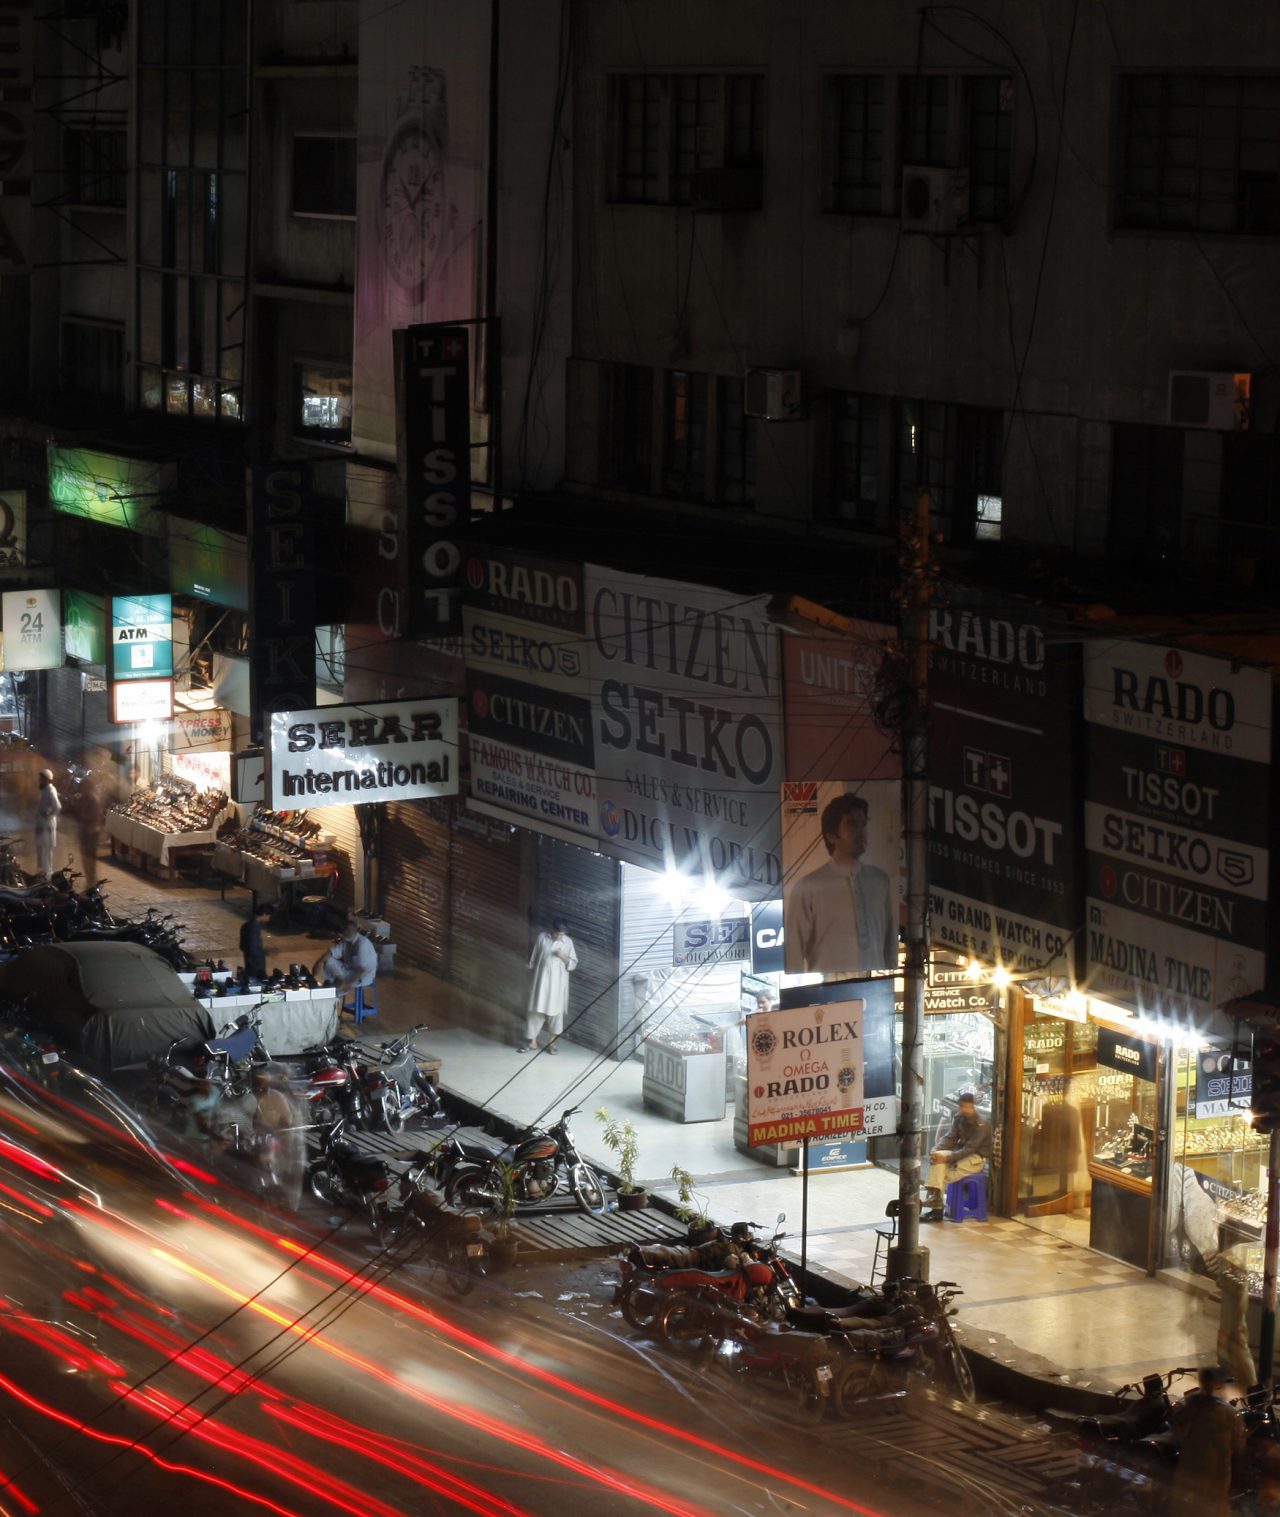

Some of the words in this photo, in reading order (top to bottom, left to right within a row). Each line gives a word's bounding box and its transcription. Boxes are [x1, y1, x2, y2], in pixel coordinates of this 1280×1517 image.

[420, 367, 460, 623] TISSOT
[265, 471, 309, 709] SEIK
[488, 560, 577, 612] RADO
[21, 612, 43, 633] 24
[119, 628, 147, 640] ATM
[592, 586, 769, 696] CITIZEN
[929, 608, 1046, 670] RADO
[472, 625, 555, 672] SEIKO
[560, 651, 578, 673] 5
[928, 653, 1046, 697] SWITZERLAND
[490, 694, 585, 746] CITIZEN
[1112, 668, 1234, 731] RADO
[178, 718, 223, 728] XPRESS
[191, 726, 230, 738] MONEY
[288, 713, 443, 752] SEHAR
[601, 679, 773, 785] SEIKO
[1113, 711, 1234, 749] SWITZERLAND
[283, 755, 449, 796] International
[472, 740, 522, 776] FAMOUS
[525, 754, 571, 792] WATCH
[574, 771, 596, 799] CO.
[477, 779, 537, 810] REPAIRING
[541, 799, 589, 826] CENTER
[525, 783, 560, 801] SERVICE
[625, 769, 669, 805] SALES
[672, 783, 682, 808] &
[686, 787, 748, 827] SERVICE
[1122, 766, 1219, 821] TISSOT
[929, 785, 1063, 866] TISSOT
[952, 849, 1000, 875] WATCHES
[1103, 814, 1211, 875] SEIKO
[1222, 853, 1248, 881] 5
[1122, 871, 1235, 934] CITIZEN
[684, 922, 750, 948] SEI
[929, 895, 944, 915] EW
[948, 901, 991, 933] GRAND
[995, 916, 1041, 950] WATCH
[1045, 933, 1068, 959] CO.
[941, 926, 977, 950] SALES
[1090, 930, 1159, 985] MADINA
[1165, 956, 1212, 1002] TIME
[925, 997, 965, 1009] Watch
[969, 996, 989, 1006] Co.
[783, 1020, 858, 1049] ROLEX
[1027, 1038, 1062, 1050] RADO
[1115, 1045, 1139, 1061] RADO
[767, 1074, 830, 1098] RADO
[783, 1060, 829, 1078] OMEGA
[753, 1119, 816, 1142] MADINA
[821, 1113, 860, 1128] TIME
[874, 1102, 888, 1111] CO.
